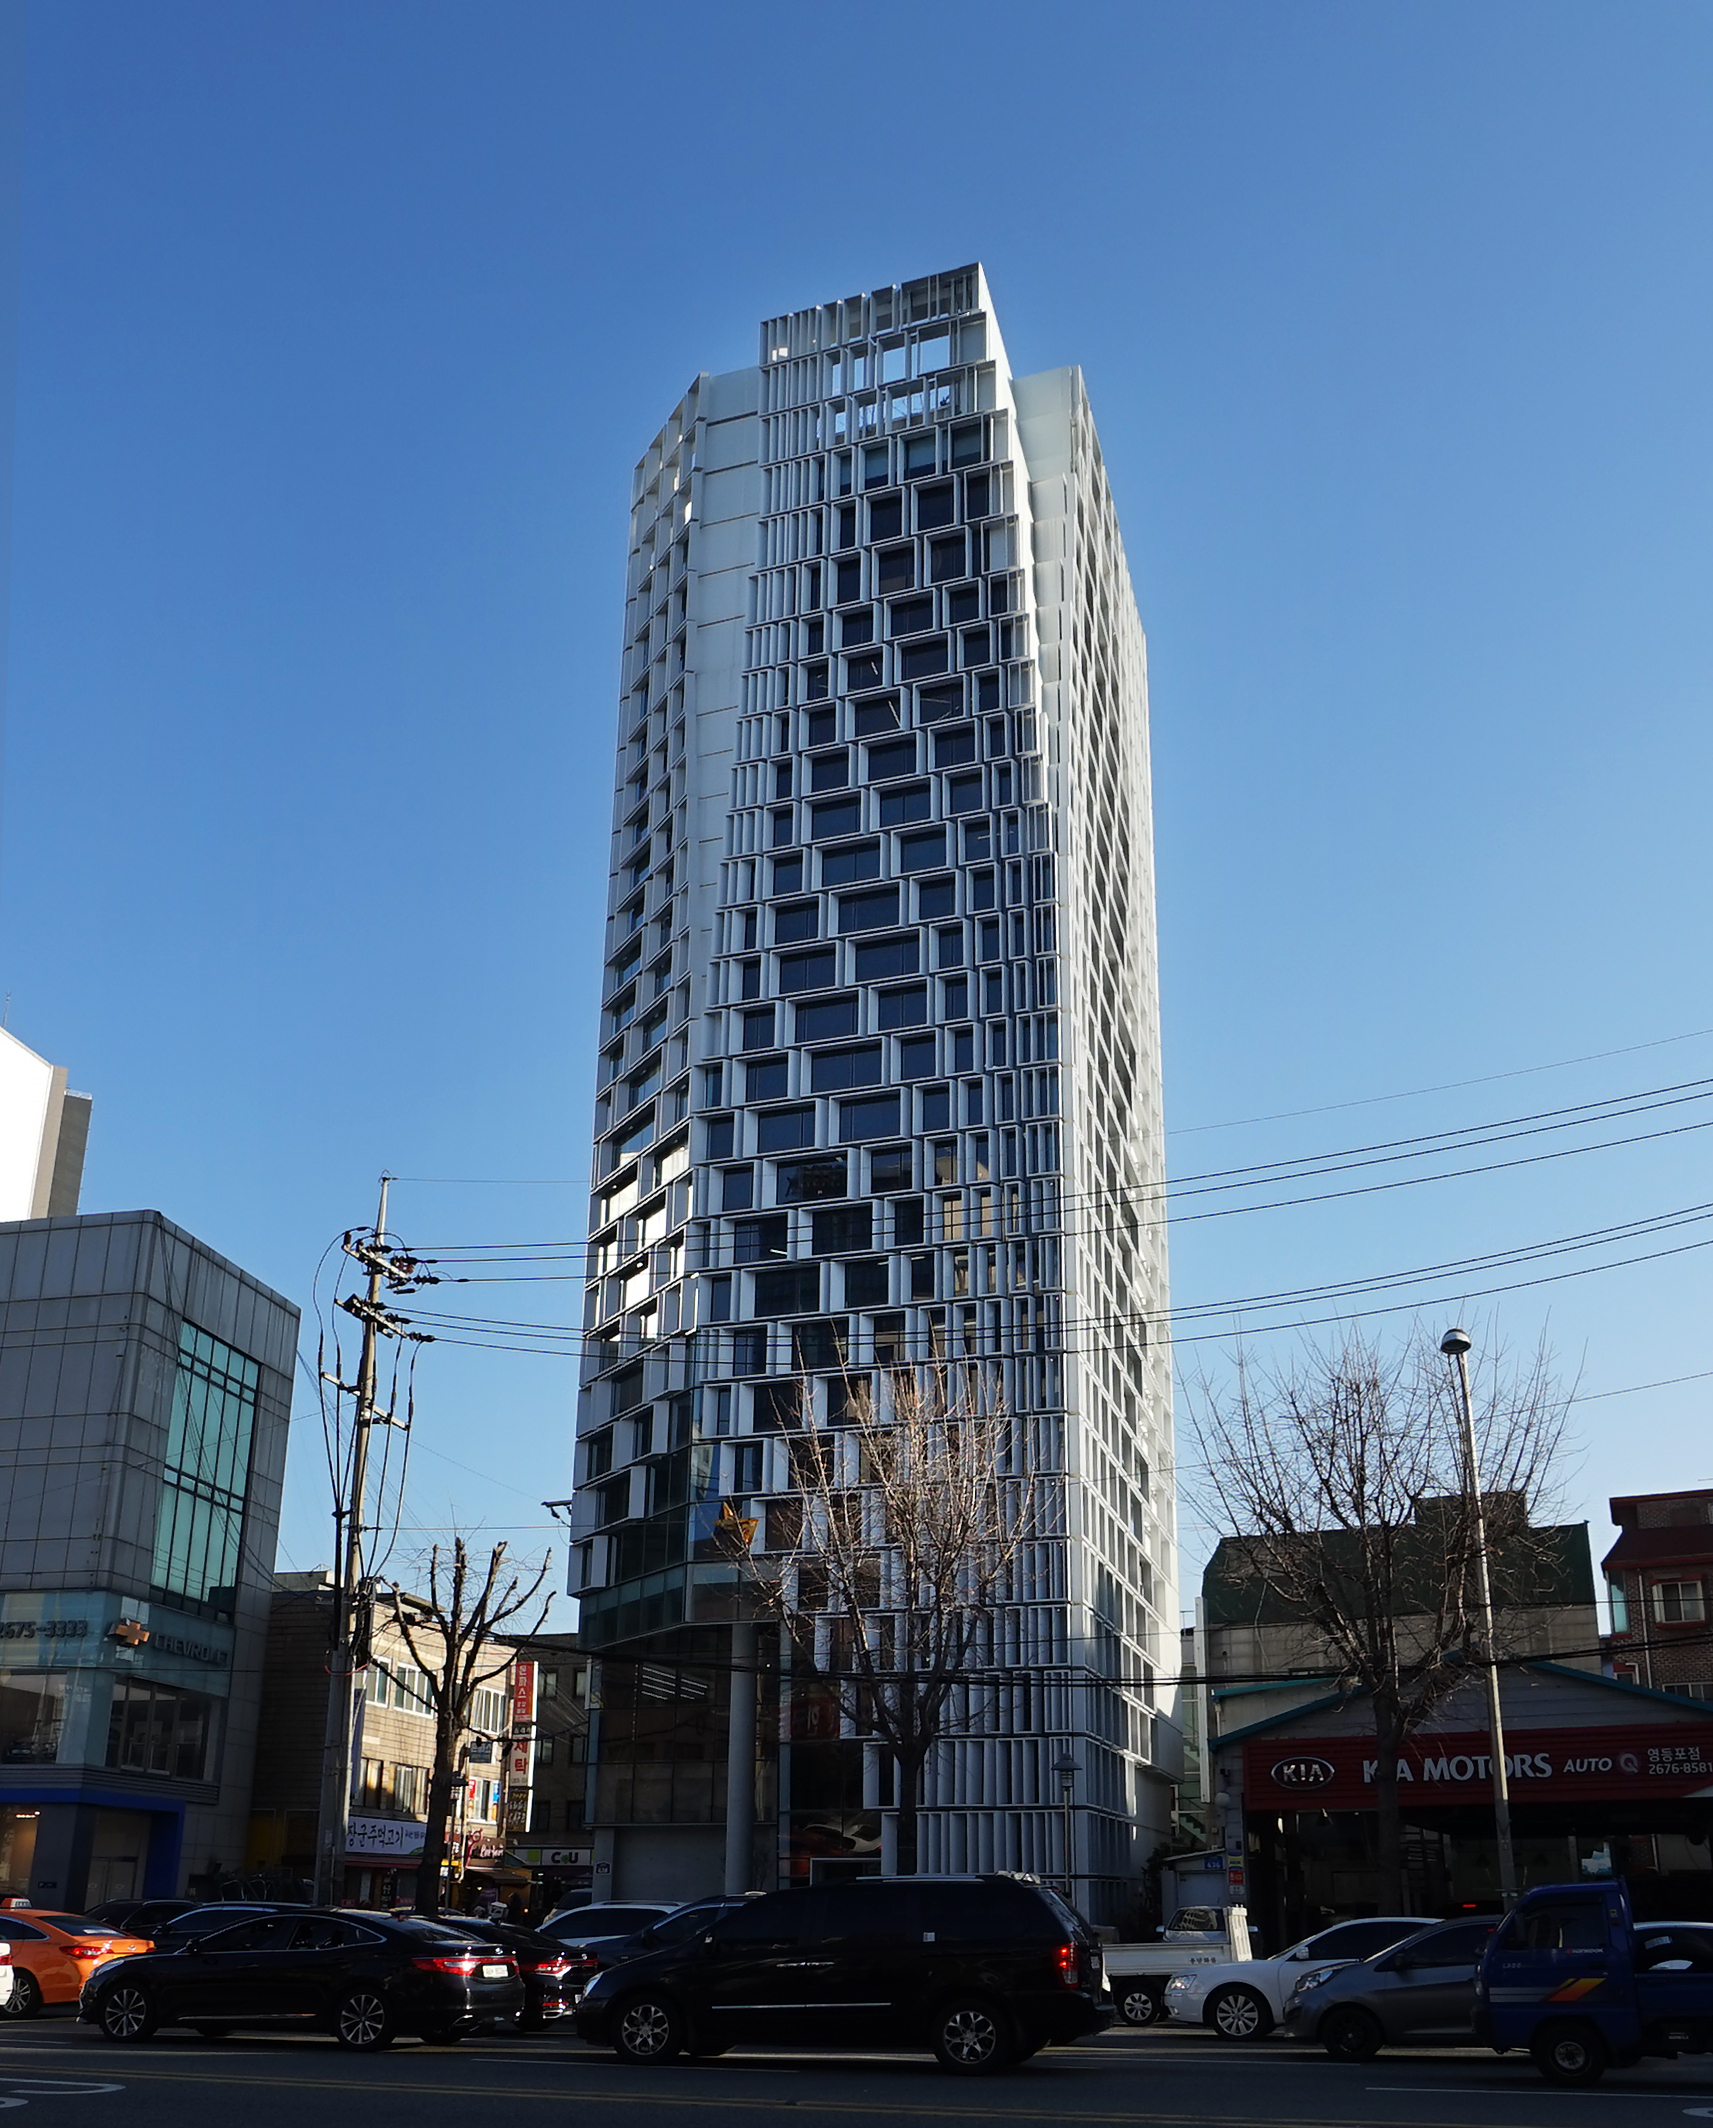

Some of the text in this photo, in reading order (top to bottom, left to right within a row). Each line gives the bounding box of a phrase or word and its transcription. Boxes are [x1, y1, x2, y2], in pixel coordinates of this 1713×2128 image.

[1647, 1746, 1700, 1762] 영등포점
[1282, 1763, 1325, 1782] KIA
[1362, 1758, 1415, 1784] KA
[1562, 1757, 1613, 1773] AUTO
[1619, 1753, 1639, 1774] Q
[1648, 1762, 1713, 1775] 2676-8581
[550, 1852, 578, 1864] CU
